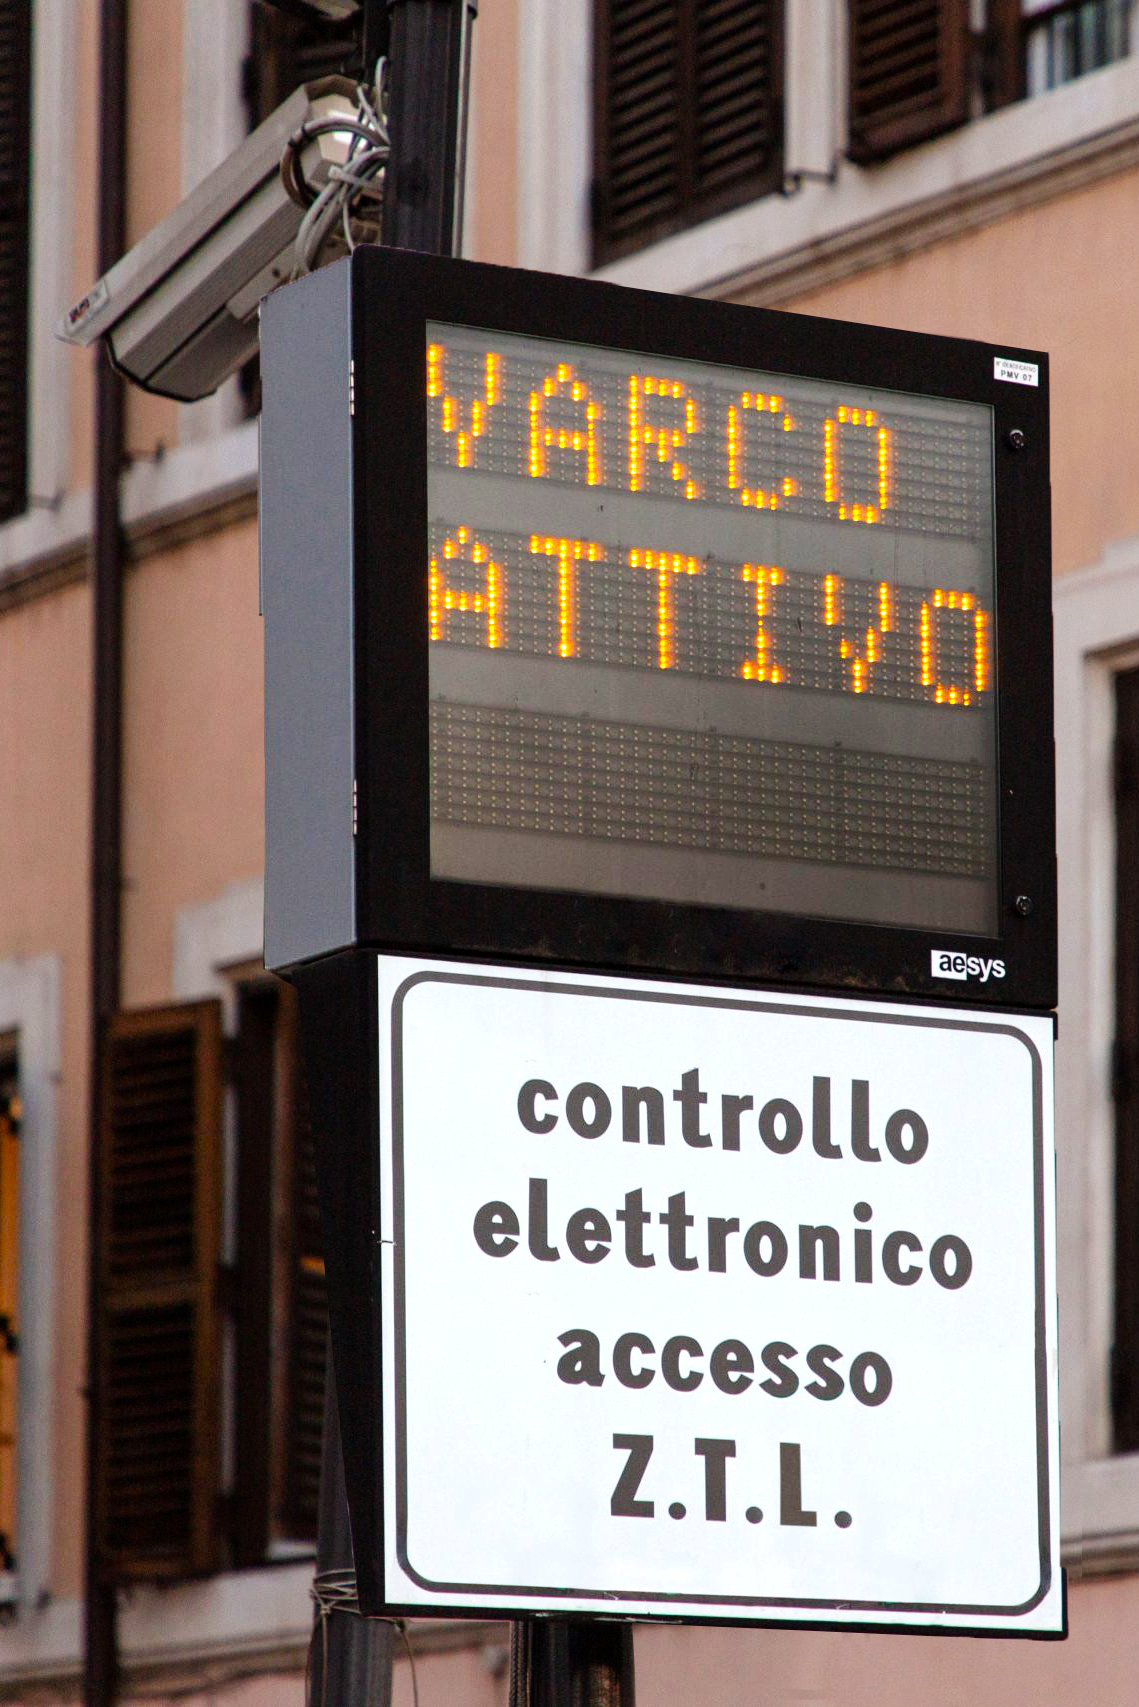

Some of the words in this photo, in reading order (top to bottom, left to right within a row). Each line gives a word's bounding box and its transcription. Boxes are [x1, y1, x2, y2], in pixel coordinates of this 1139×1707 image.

[1000, 369, 1020, 380] PMV
[1022, 373, 1032, 381] 07
[427, 343, 892, 524] VARCO
[429, 525, 990, 706] ATTIVO
[938, 953, 1007, 983] aesys
[517, 1067, 929, 1165] controllo
[473, 1177, 973, 1290] elettronico
[556, 1328, 893, 1407] accesso
[610, 1432, 853, 1529] Z.T.L.
